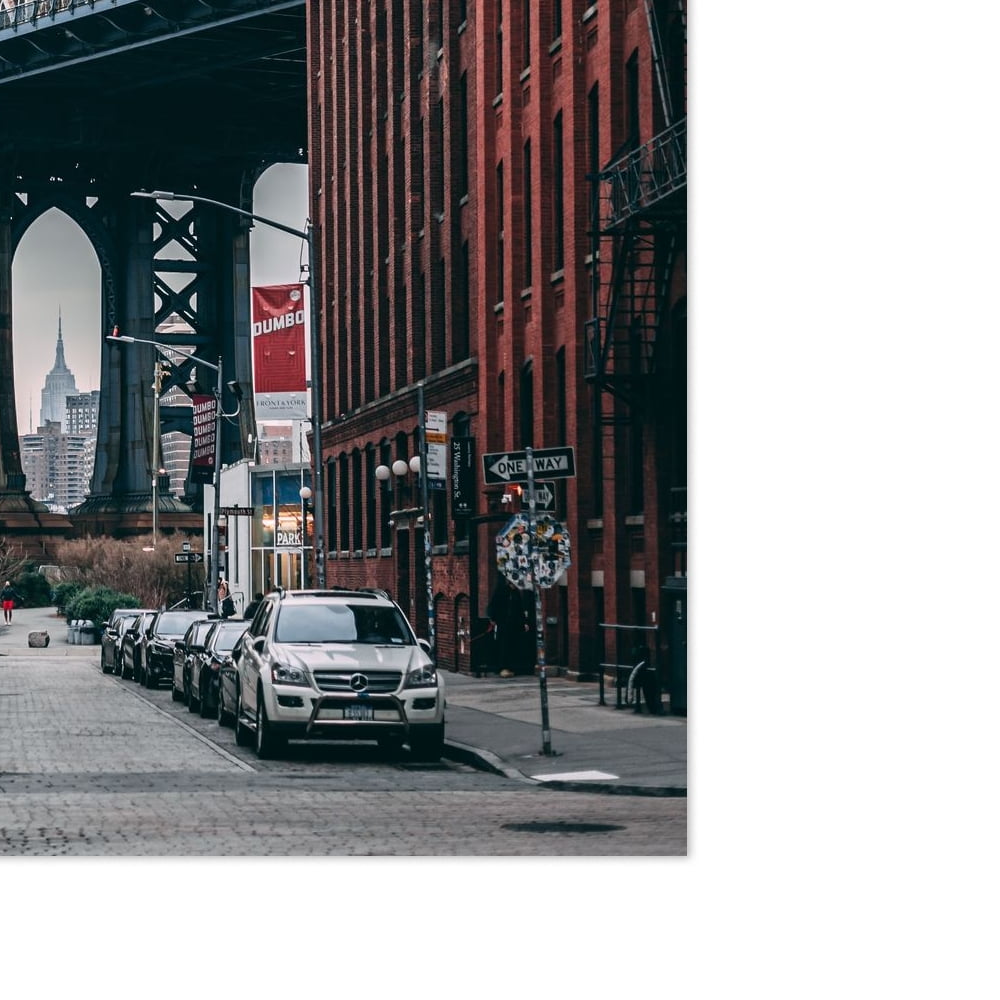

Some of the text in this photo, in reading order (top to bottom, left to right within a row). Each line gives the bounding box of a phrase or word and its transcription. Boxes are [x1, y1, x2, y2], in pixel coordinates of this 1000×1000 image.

[253, 310, 305, 337] DUMBO
[193, 400, 216, 415] DUMBO
[193, 411, 216, 426] DUMBO
[194, 422, 216, 437] DUMBO
[194, 433, 216, 448] DUMBO
[498, 457, 562, 475] ONE WAY
[277, 532, 302, 546] PARK
